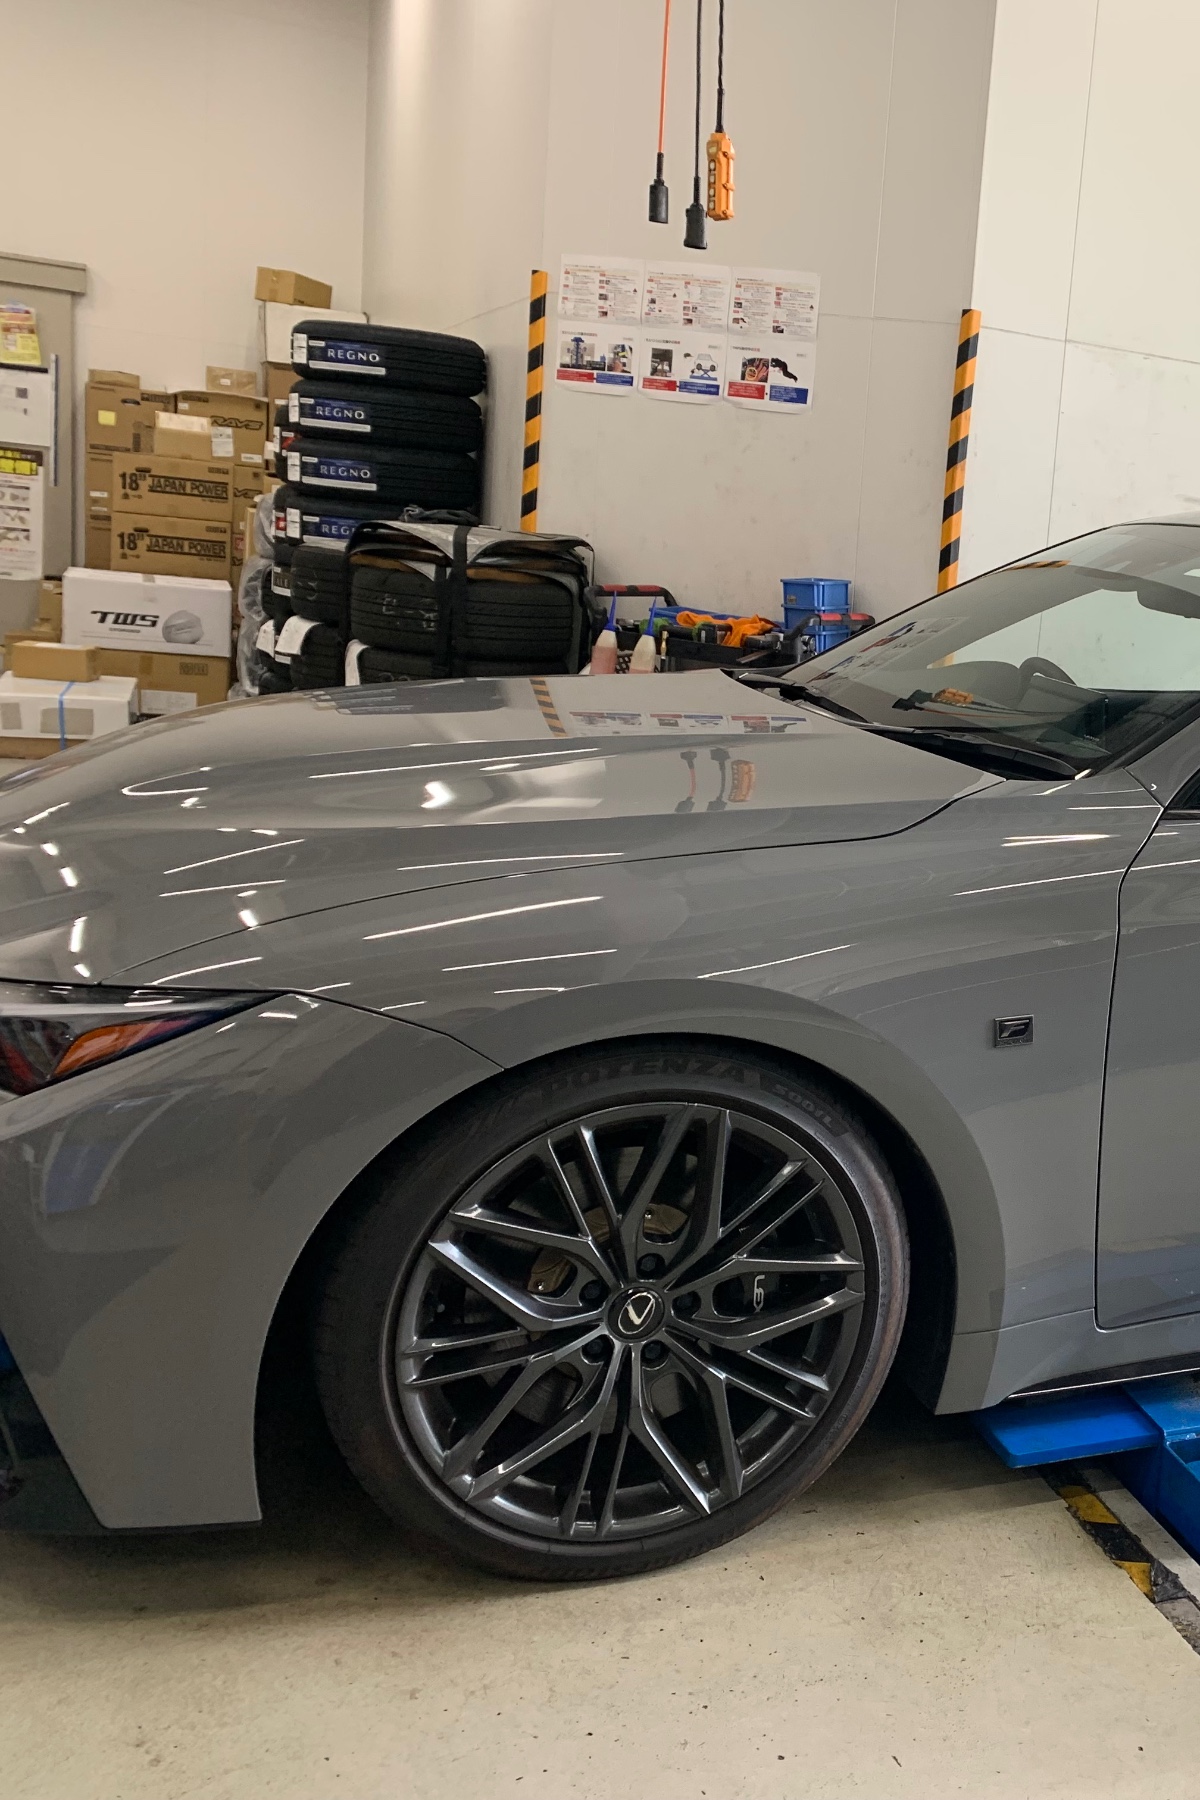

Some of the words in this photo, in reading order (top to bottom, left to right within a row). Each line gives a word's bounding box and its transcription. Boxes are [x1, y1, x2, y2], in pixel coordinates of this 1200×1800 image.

[327, 348, 380, 362] REGNO
[316, 406, 365, 420] REGNO
[320, 464, 371, 478] REGNO
[149, 480, 186, 493] JAPAN
[190, 483, 229, 498] POWER
[150, 540, 184, 553] JAPAN
[188, 544, 227, 558] POWER
[91, 610, 160, 628] TWS
[547, 1055, 749, 1092] POTENZA
